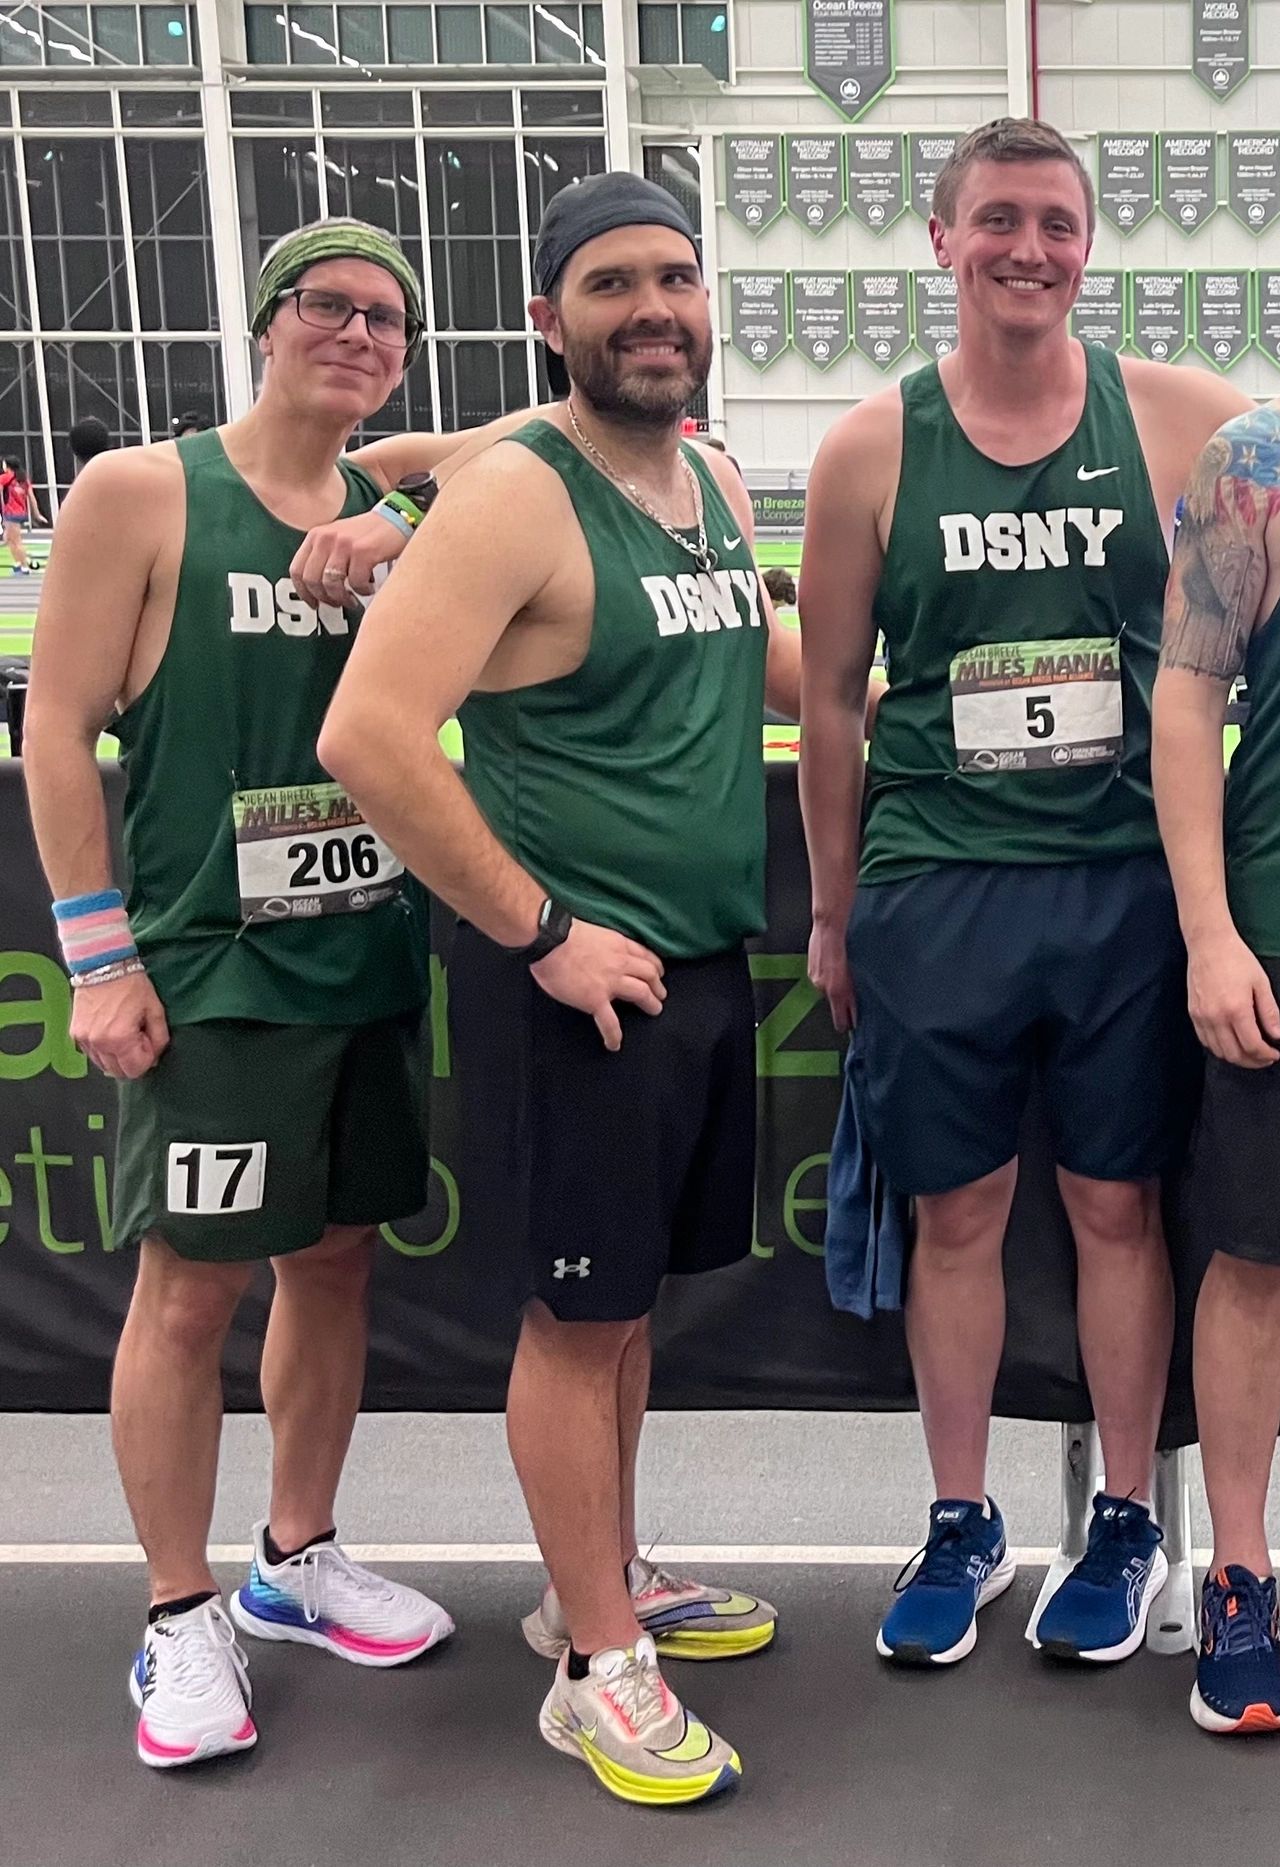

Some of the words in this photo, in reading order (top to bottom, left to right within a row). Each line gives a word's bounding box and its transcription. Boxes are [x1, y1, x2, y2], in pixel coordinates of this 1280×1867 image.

[1103, 139, 1149, 149] AMERICAN
[1165, 139, 1211, 149] AMERICAN
[1233, 138, 1279, 147] AMERICAN
[1108, 148, 1144, 156] RECORD
[1170, 148, 1206, 156] RECORD
[1238, 146, 1274, 155] RECORD
[1084, 276, 1115, 284] ANADIAN
[763, 497, 805, 509] Breeze
[763, 510, 804, 523] Comple
[939, 507, 1124, 572] DSNY
[228, 570, 362, 637] DS
[640, 569, 761, 637] DSNY
[956, 657, 1025, 681] MILES
[1031, 652, 1115, 677] MANIA
[1025, 695, 1055, 738] 5
[242, 801, 321, 828] MILES
[287, 834, 379, 888] 206
[175, 1148, 253, 1210] 17
